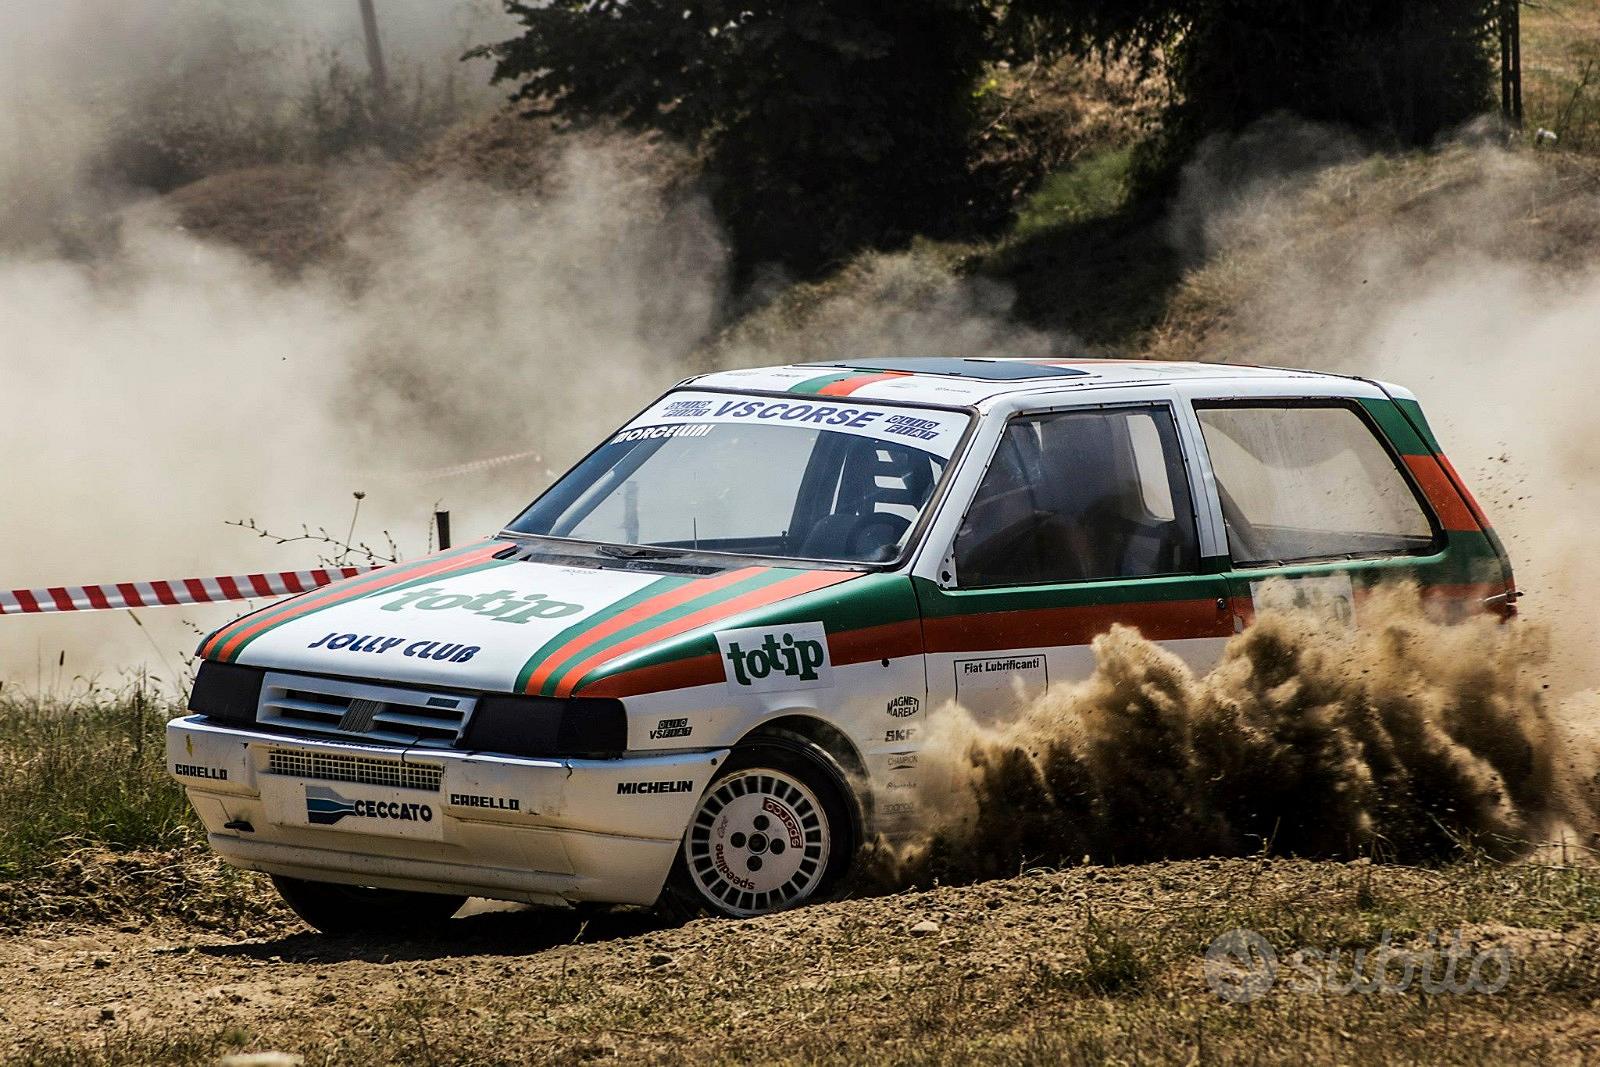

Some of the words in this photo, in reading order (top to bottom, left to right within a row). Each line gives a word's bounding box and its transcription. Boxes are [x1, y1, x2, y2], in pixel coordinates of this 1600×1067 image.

[885, 414, 940, 429] OLIO
[884, 424, 940, 440] FIAT
[381, 588, 584, 624] totip
[308, 632, 405, 654] JOLLY
[402, 640, 481, 663] CLUB
[727, 632, 824, 686] totip
[964, 663, 982, 673] Fiat
[985, 658, 1039, 672] Lubrificanti
[885, 729, 916, 742] SKF
[175, 763, 228, 780] CARELLO
[617, 780, 693, 794] MICHELIN
[450, 793, 520, 811] CARELLO
[354, 800, 433, 822] CECCATO
[715, 843, 756, 890] speedline
